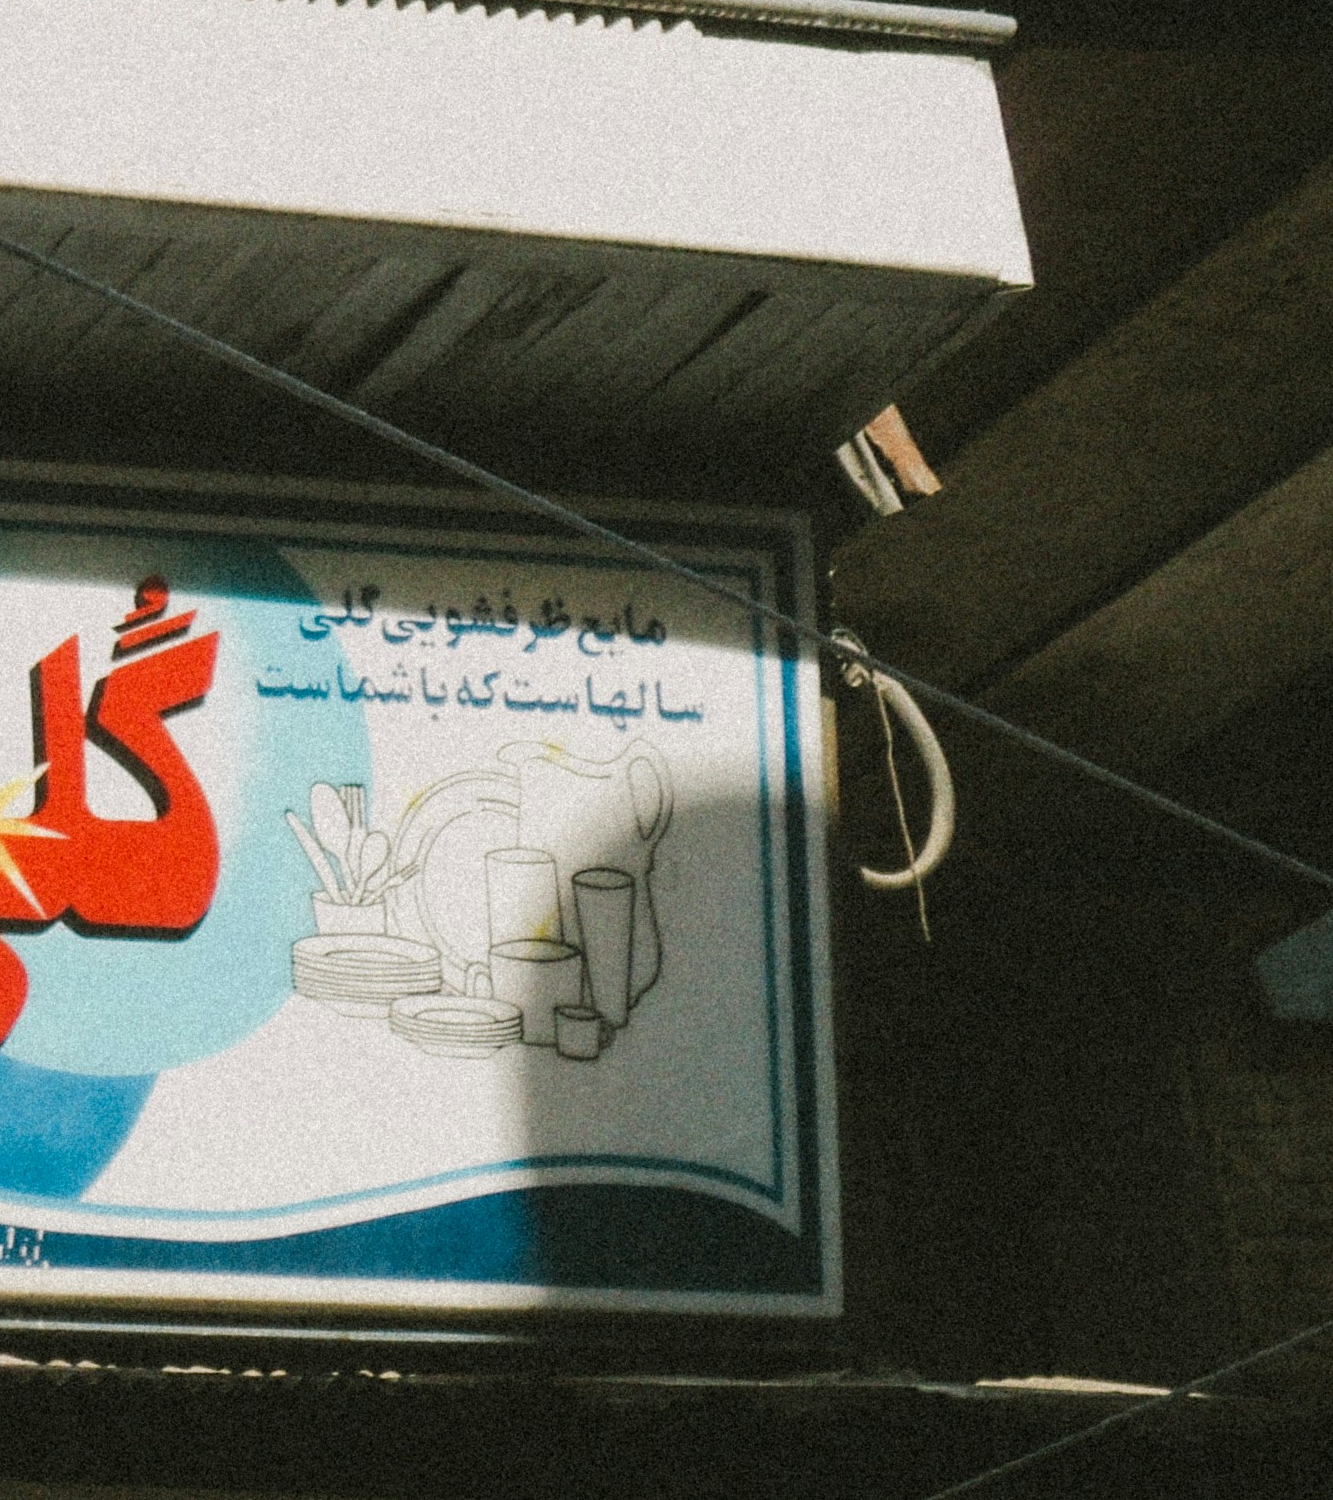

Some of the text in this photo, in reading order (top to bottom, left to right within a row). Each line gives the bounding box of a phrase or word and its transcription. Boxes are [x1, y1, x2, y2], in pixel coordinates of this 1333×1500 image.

[577, 603, 668, 656] مایع
[419, 666, 448, 722] با
[457, 670, 500, 707] که
